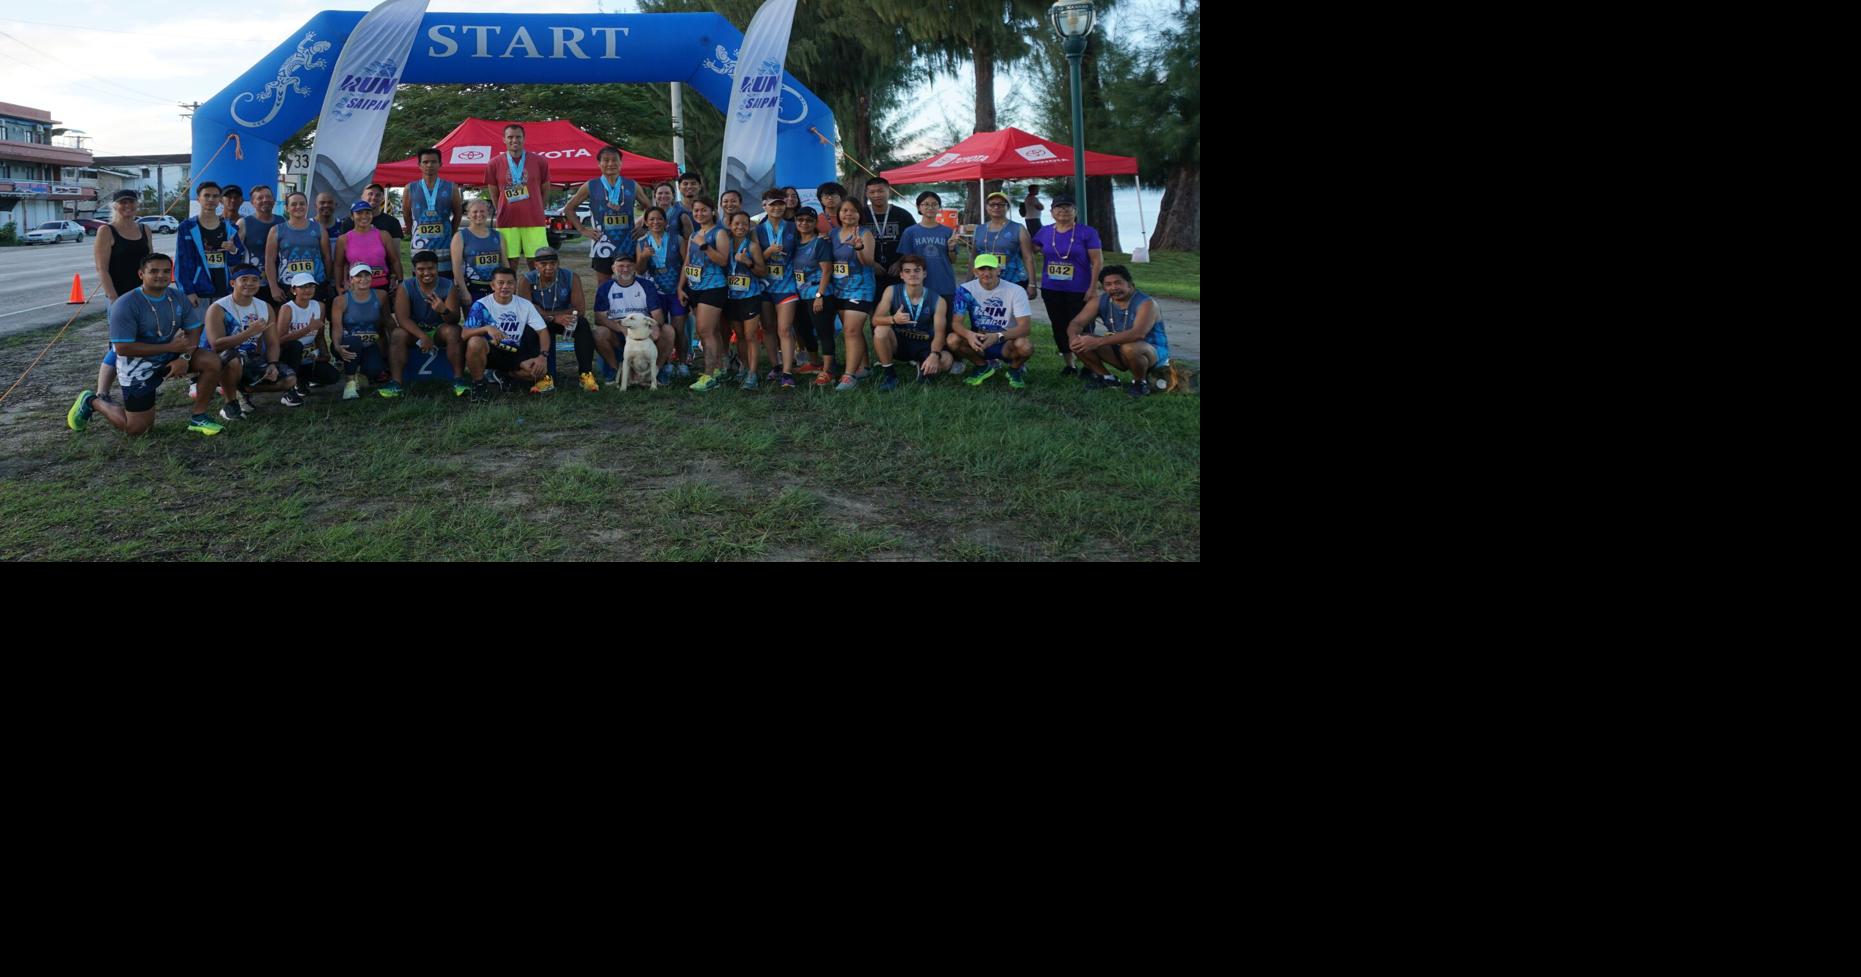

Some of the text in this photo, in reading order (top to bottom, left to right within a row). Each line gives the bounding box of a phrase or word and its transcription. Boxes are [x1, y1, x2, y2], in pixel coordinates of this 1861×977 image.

[427, 24, 630, 60] START
[340, 74, 398, 95] RUN
[741, 74, 780, 93] RUN
[346, 98, 391, 111] SAIPAN
[294, 154, 310, 169] 33
[607, 216, 626, 225] 011
[420, 224, 441, 234] 023
[206, 254, 223, 264] 45
[479, 254, 497, 265] 038
[290, 262, 312, 272] 016
[685, 267, 699, 278] 013
[832, 264, 846, 274] 43
[1049, 265, 1071, 275] 042
